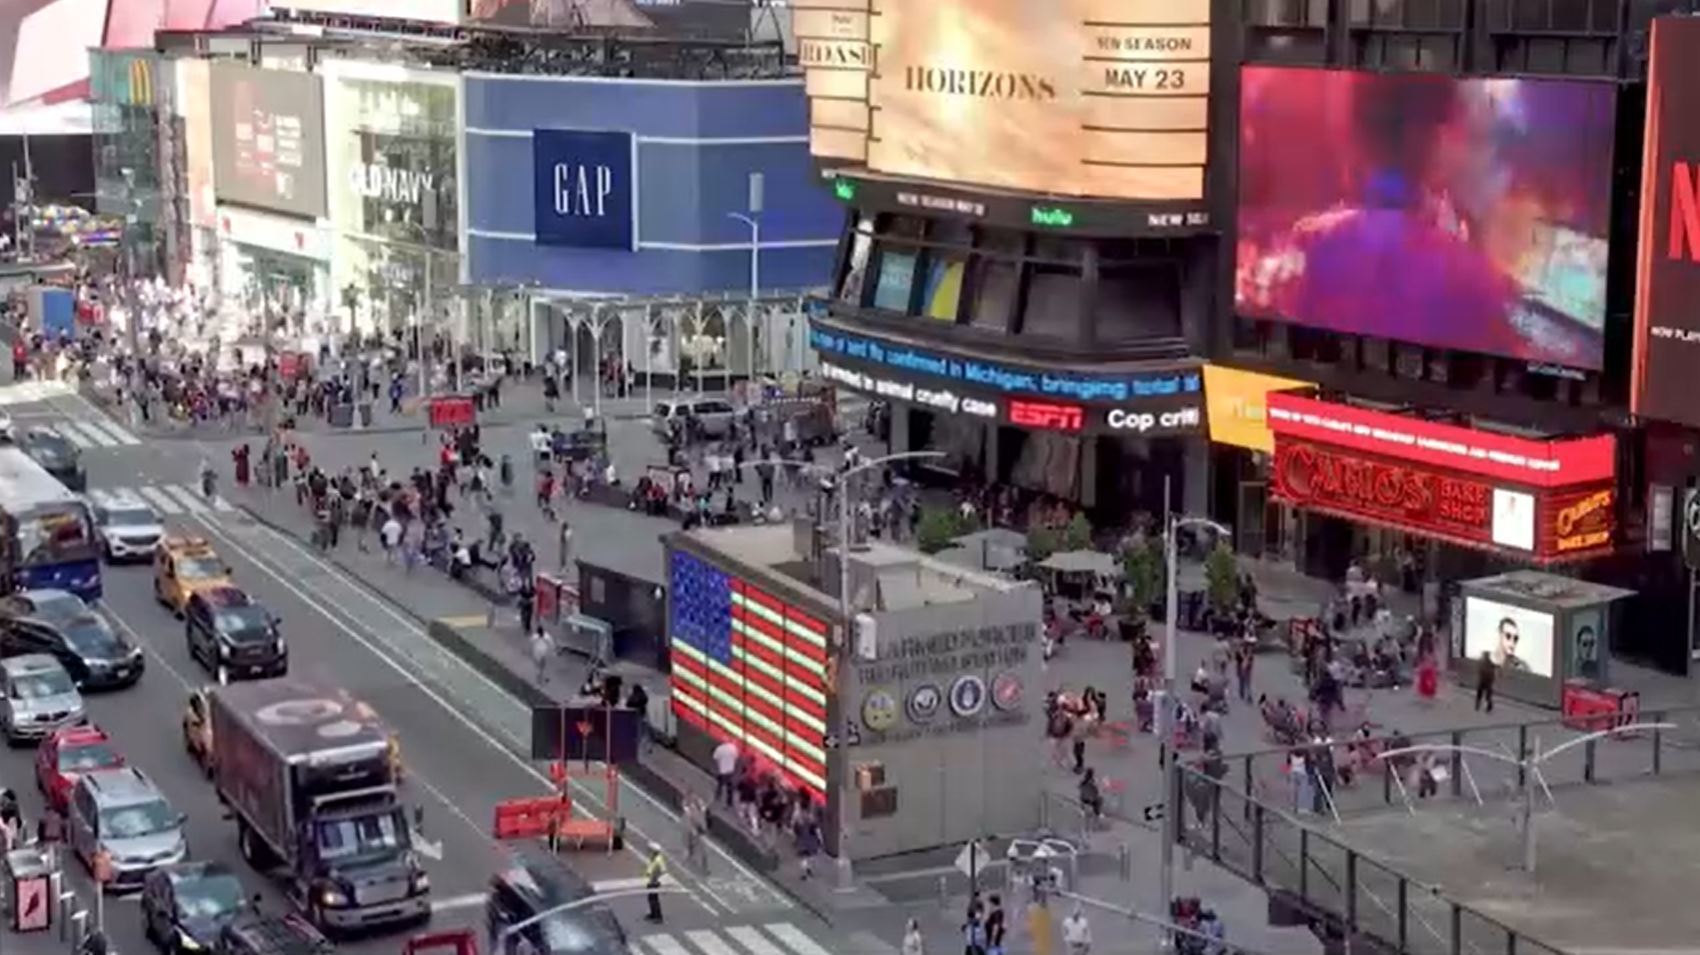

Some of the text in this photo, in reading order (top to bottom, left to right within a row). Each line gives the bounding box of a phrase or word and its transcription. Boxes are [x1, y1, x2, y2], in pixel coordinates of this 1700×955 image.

[1124, 38, 1192, 50] SEASON
[906, 65, 1056, 99] HORIZONS
[1105, 68, 1185, 89] MAY 23
[554, 162, 612, 216] GAP
[1032, 207, 1073, 227] hulu
[1042, 373, 1126, 400] bringing
[962, 397, 997, 417] case
[1010, 401, 1082, 430] ESPN
[1108, 409, 1155, 433] Cop
[1440, 480, 1486, 504] BAKE
[1439, 503, 1487, 526] SHOP
